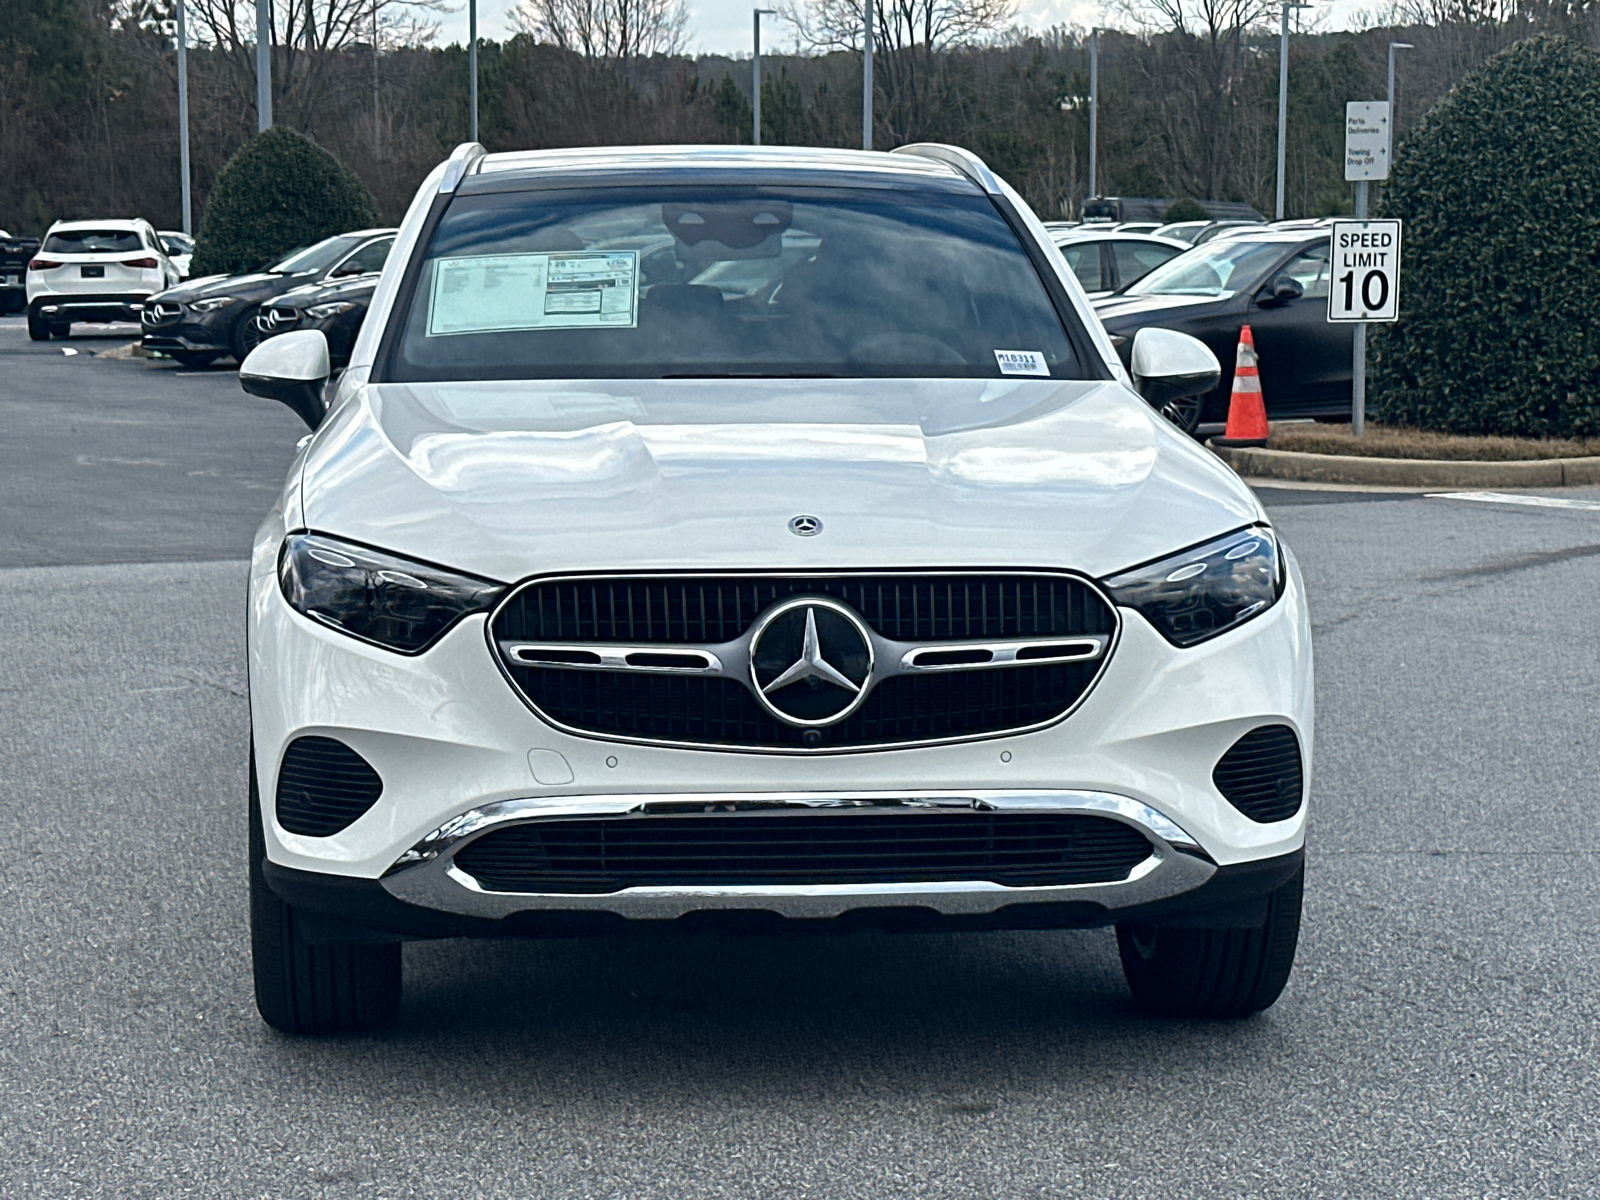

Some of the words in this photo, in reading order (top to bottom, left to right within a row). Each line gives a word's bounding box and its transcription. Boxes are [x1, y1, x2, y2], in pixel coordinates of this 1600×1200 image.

[1348, 117, 1365, 125] Parts
[1347, 126, 1379, 134] Deliveries
[1348, 148, 1370, 157] Towing
[1347, 157, 1363, 166] Drop
[1363, 156, 1375, 165] Off
[1339, 233, 1392, 248] SPEED
[1343, 252, 1388, 267] LIMIT
[1339, 270, 1389, 312] 10
